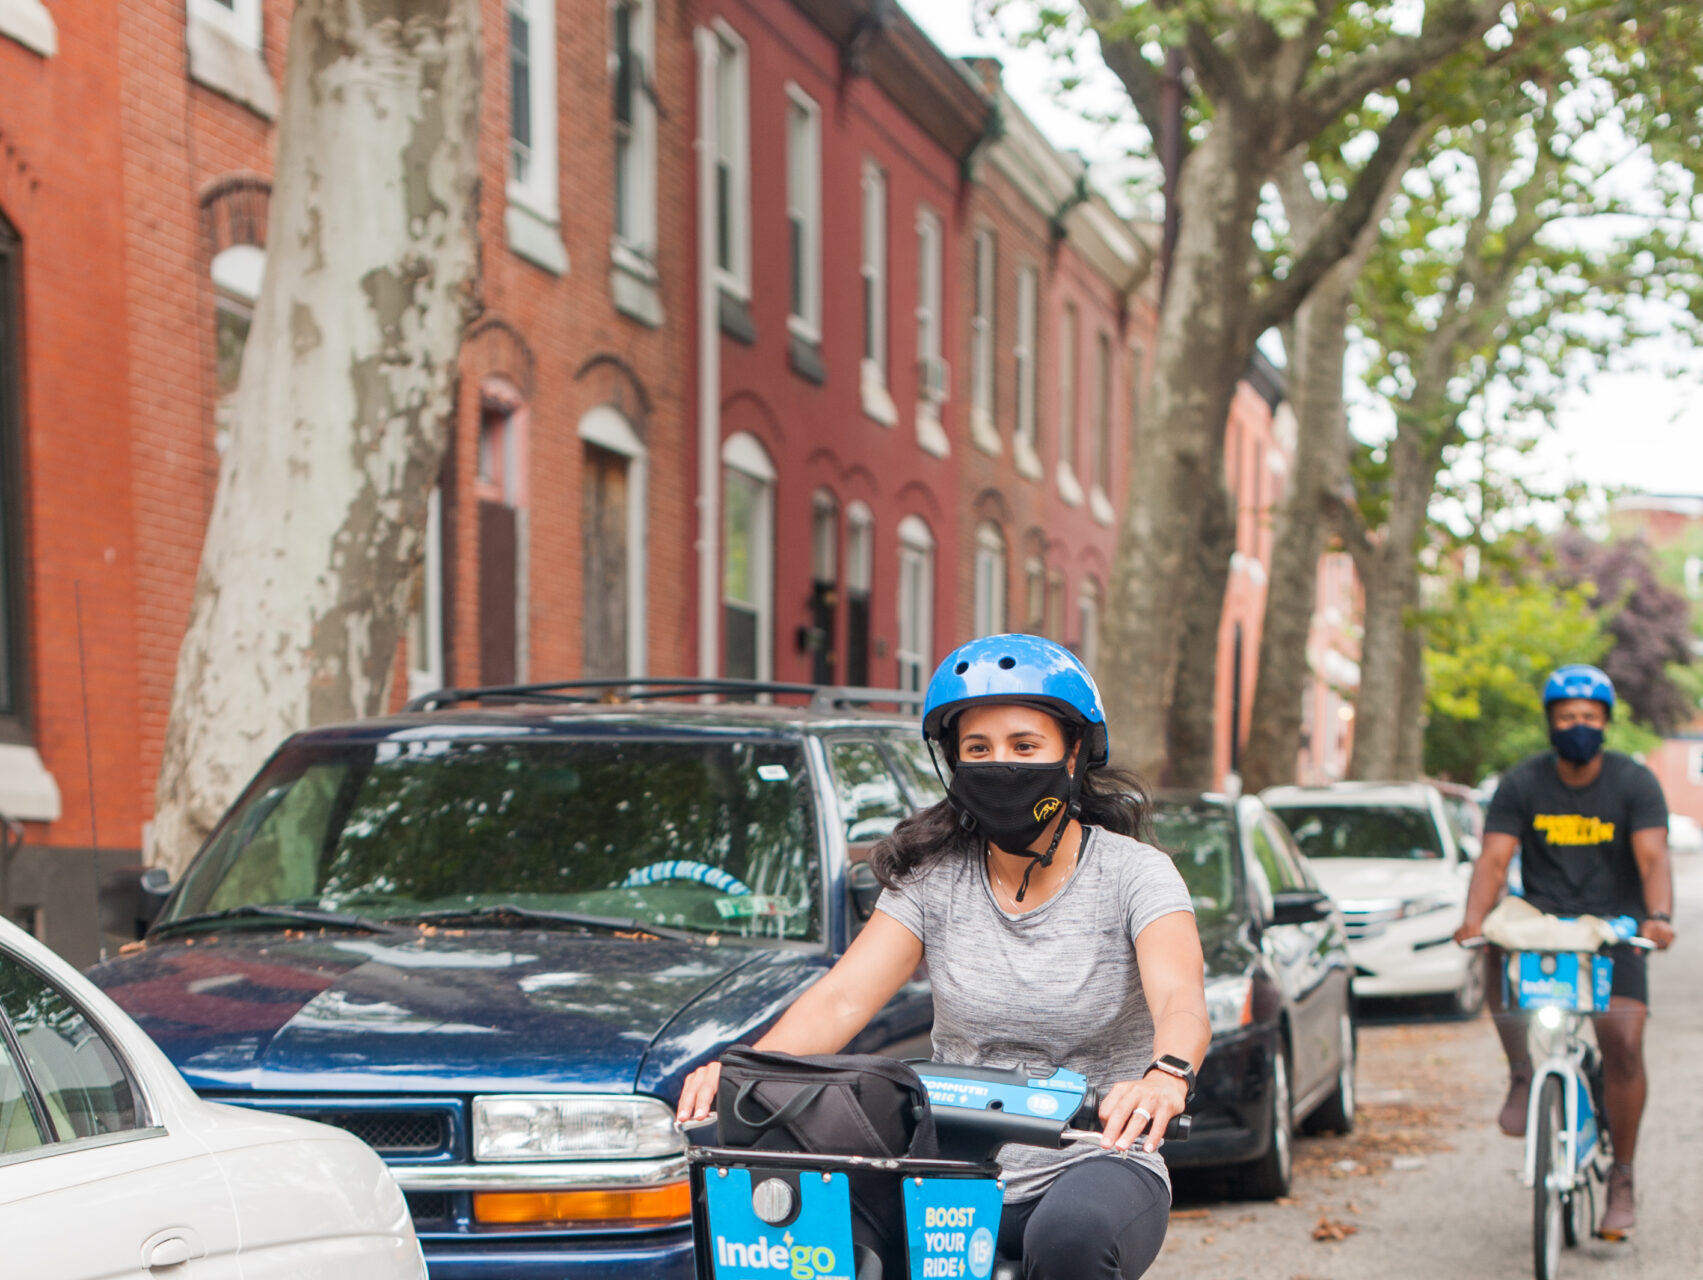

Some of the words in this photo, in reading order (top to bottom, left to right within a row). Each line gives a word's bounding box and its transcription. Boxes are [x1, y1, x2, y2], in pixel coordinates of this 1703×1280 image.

[925, 1206, 976, 1228] BOOST
[924, 1231, 966, 1253] YOUR
[716, 1235, 836, 1280] Indego
[923, 1256, 959, 1278] RIDE
